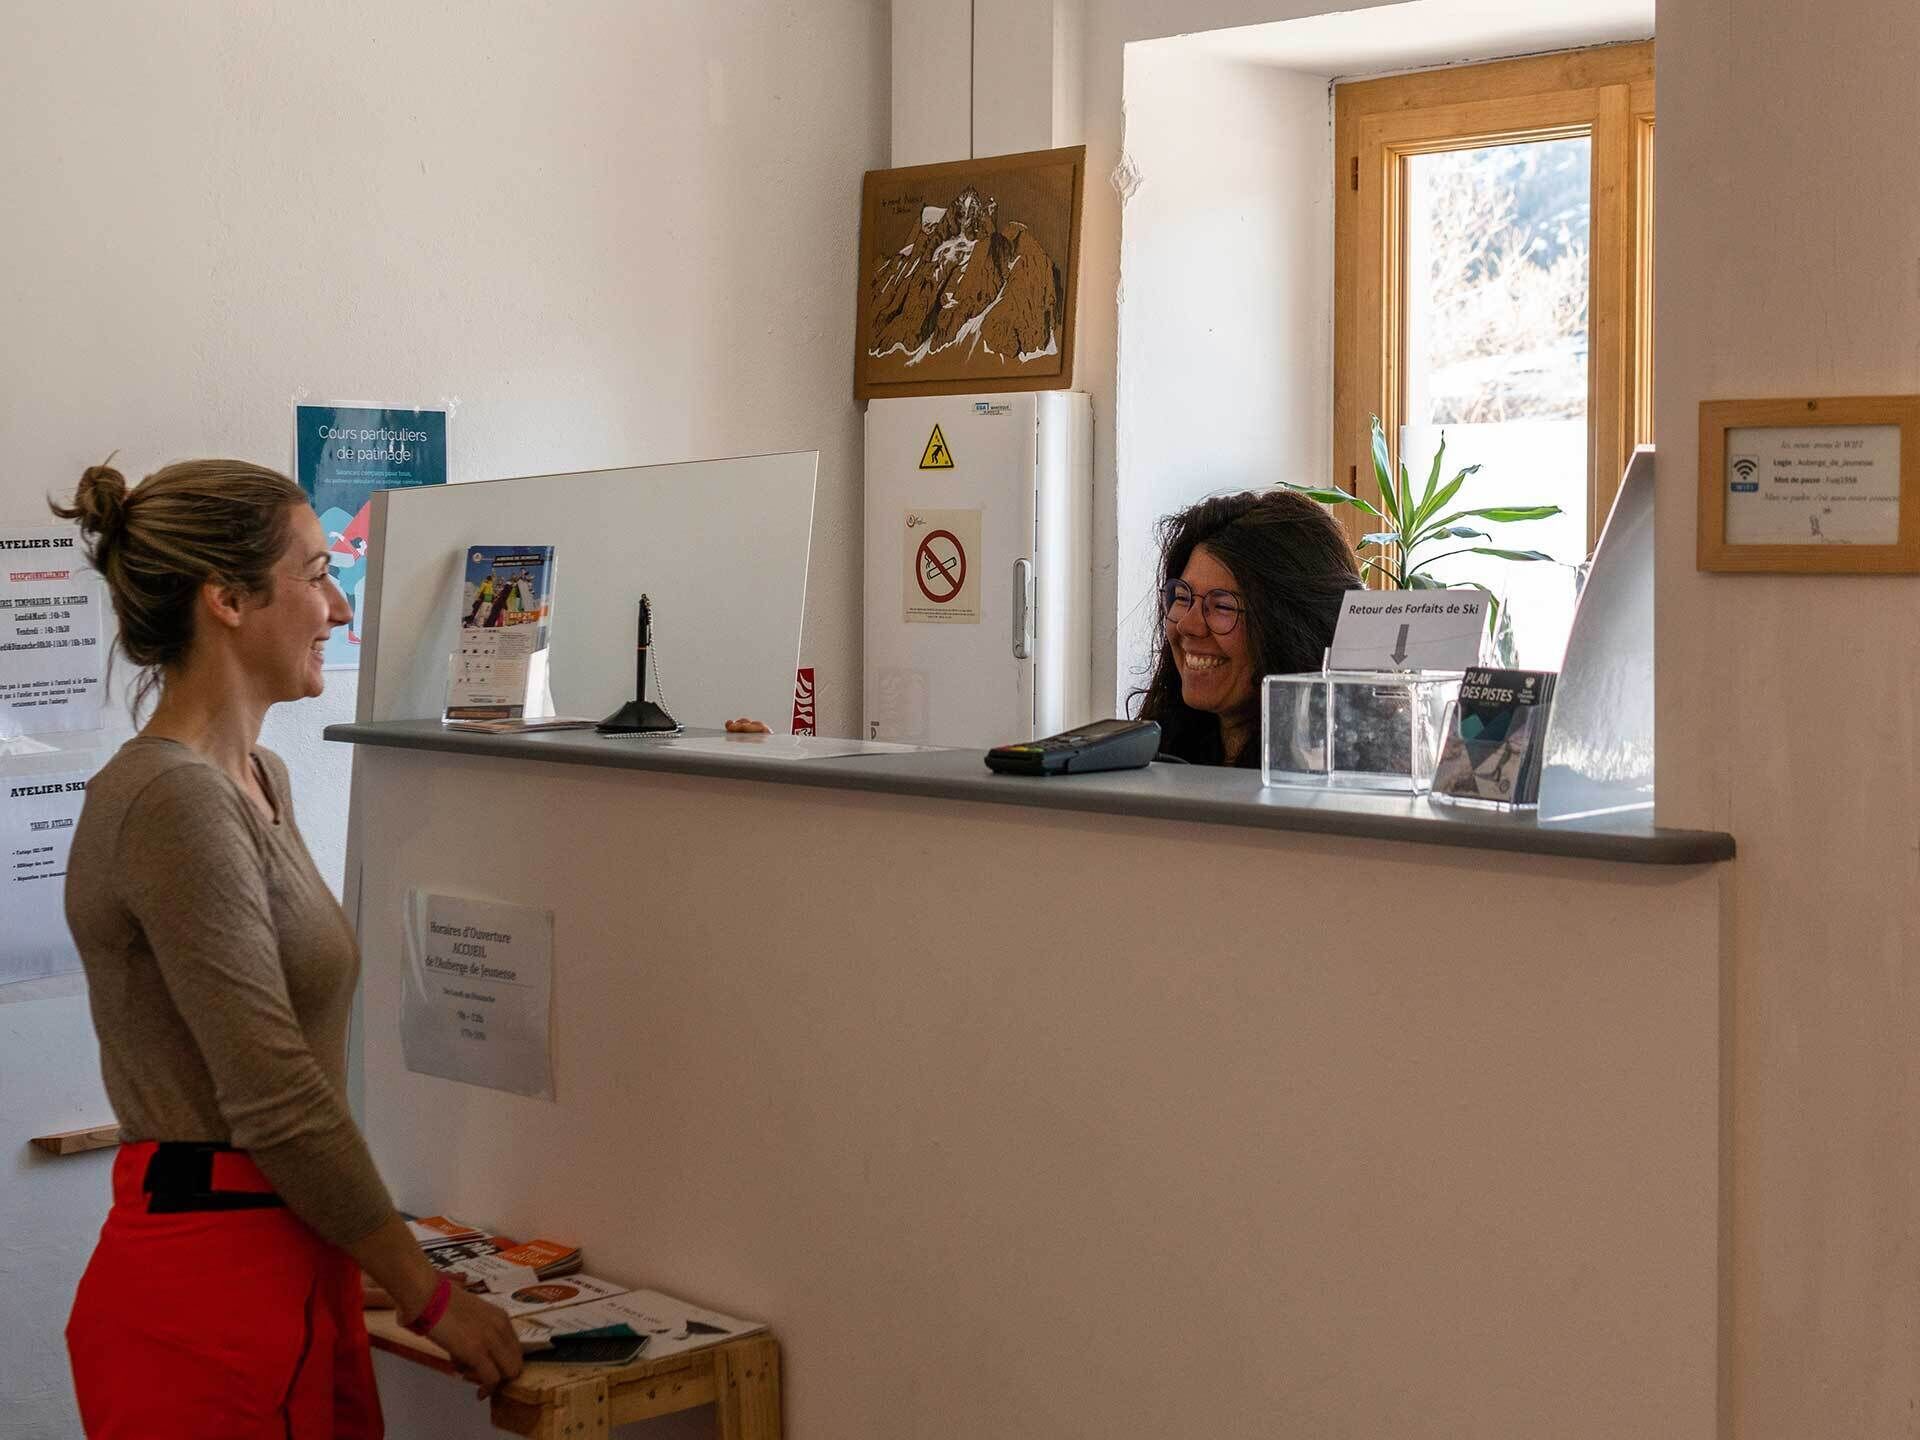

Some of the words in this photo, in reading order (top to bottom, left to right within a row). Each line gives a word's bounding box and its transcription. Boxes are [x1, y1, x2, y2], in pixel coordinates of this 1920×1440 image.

[318, 425, 357, 440] Cours
[360, 426, 428, 443] particuliers
[336, 445, 354, 460] de
[357, 446, 411, 464] patinage
[1790, 476, 1800, 484] de
[0, 539, 51, 549] ATELIER
[53, 538, 73, 548] SKI
[1349, 604, 1383, 615] Retour
[1385, 604, 1402, 614] des
[1405, 603, 1444, 614] Forfaits
[1446, 603, 1460, 614] de
[1462, 603, 1480, 615] Ski
[1465, 671, 1492, 686] PLAN
[1461, 686, 1480, 699] DES
[1480, 687, 1514, 702] PISTES
[10, 784, 63, 797] ATELIER
[65, 782, 86, 792] SKI
[430, 921, 461, 938] Horaires
[463, 926, 512, 944] d'Ouverture
[452, 942, 488, 959] ACCUEIL
[425, 954, 435, 967] de
[435, 956, 468, 977] l'Auberge
[469, 961, 480, 975] de
[480, 963, 517, 981] Jeunesse
